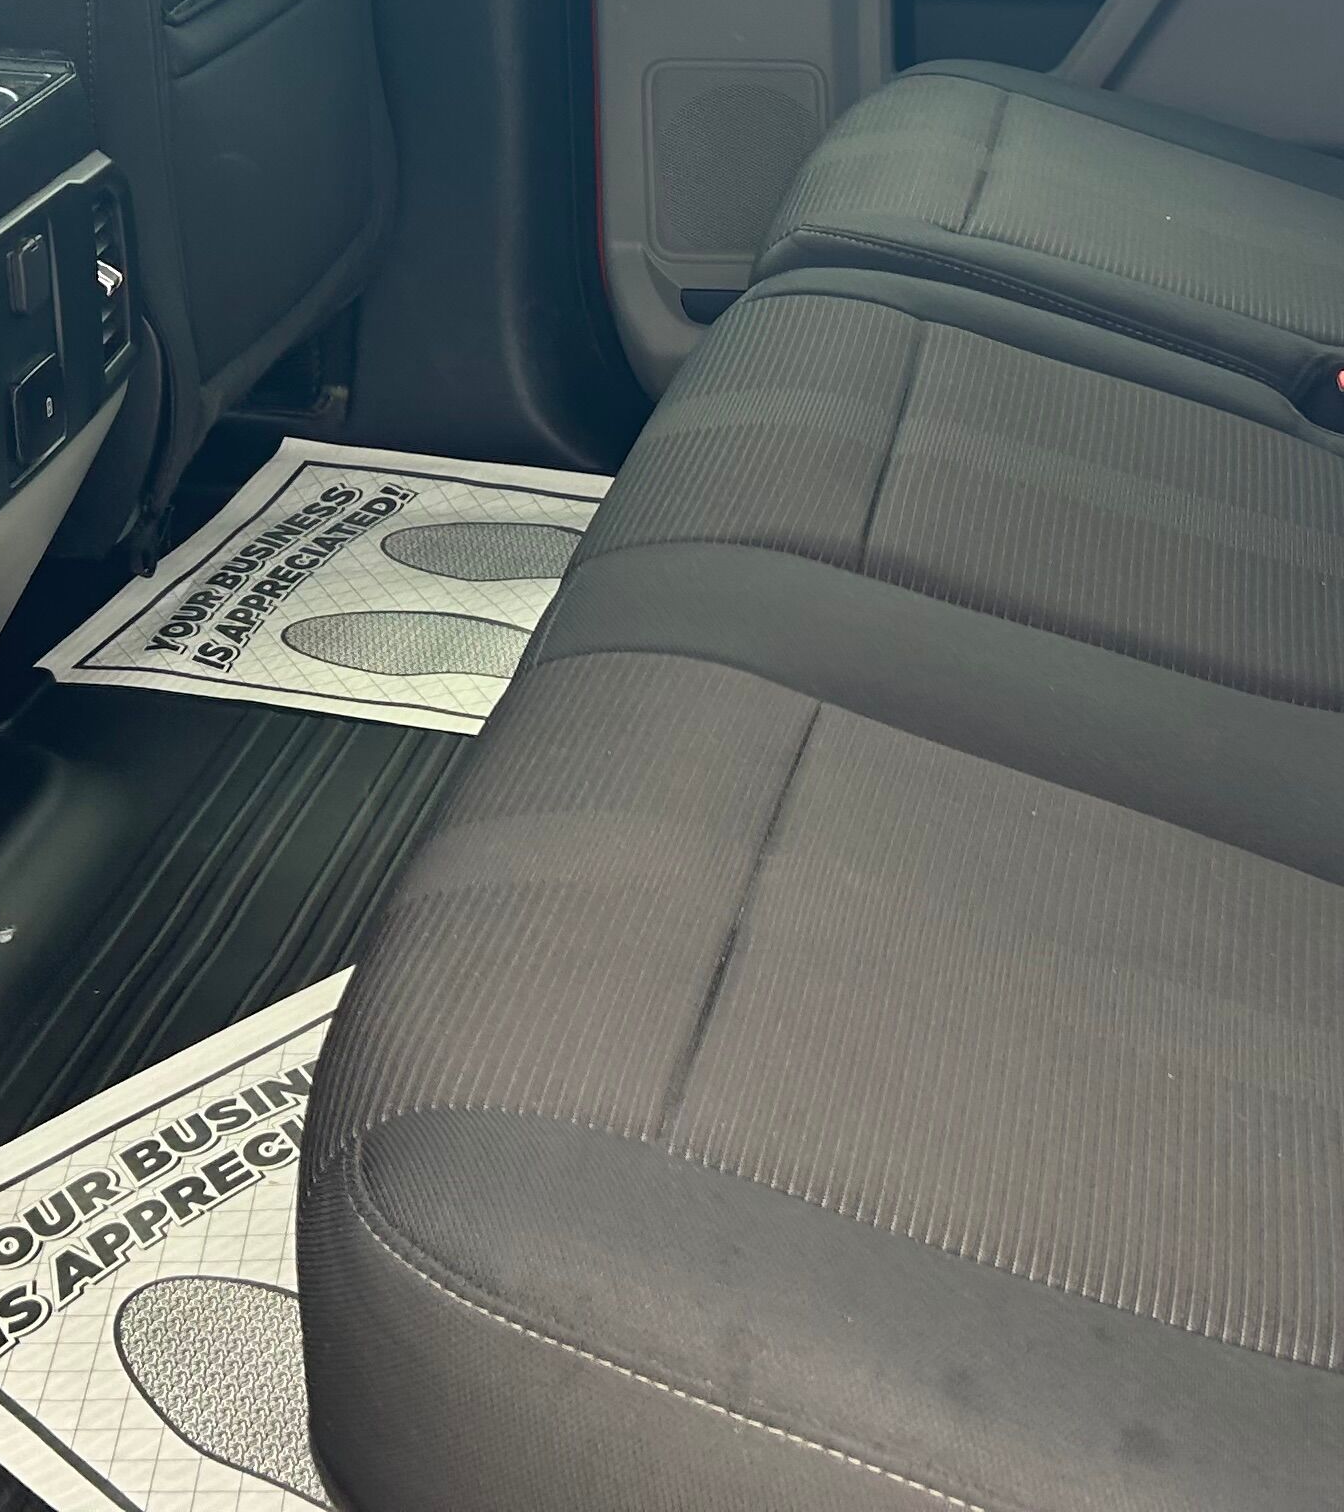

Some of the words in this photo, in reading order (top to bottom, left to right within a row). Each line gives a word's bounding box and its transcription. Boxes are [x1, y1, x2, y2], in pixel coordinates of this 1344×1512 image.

[144, 587, 224, 654] YOUR
[214, 482, 364, 590] BUSINESS
[211, 483, 418, 648] APPRECIATED!
[191, 638, 241, 673] IS
[116, 1061, 316, 1182] BUSIN
[52, 1120, 304, 1306] APPRECI
